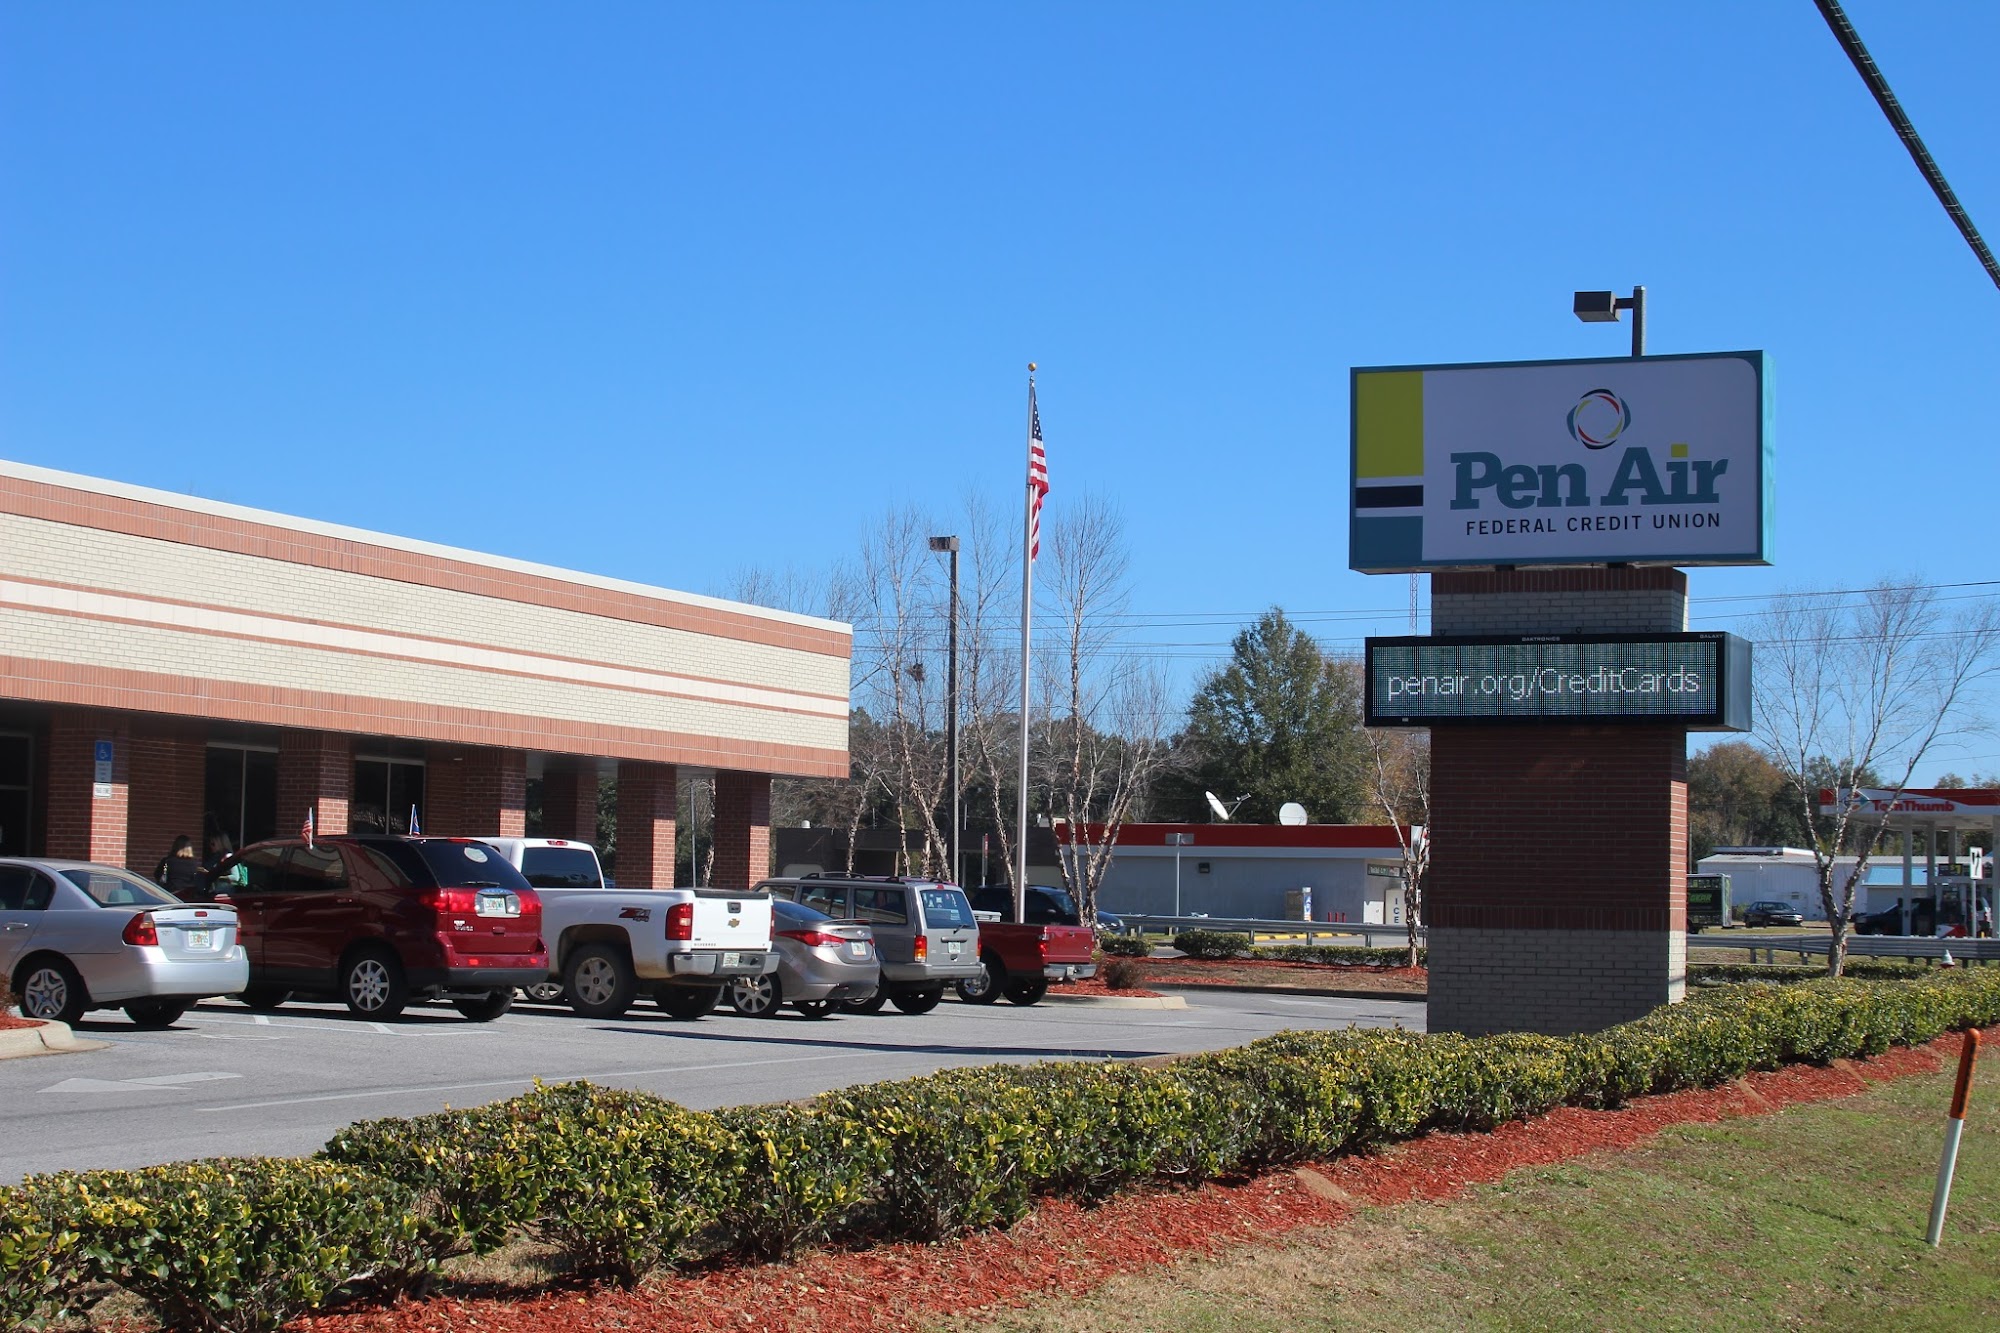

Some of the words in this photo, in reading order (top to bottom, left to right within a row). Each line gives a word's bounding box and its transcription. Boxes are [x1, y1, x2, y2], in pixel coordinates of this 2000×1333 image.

[1450, 452, 1591, 510] Pen
[1600, 444, 1729, 506] Air
[1466, 518, 1557, 536] FEDERAL
[1567, 515, 1642, 532] CREDIT
[1653, 513, 1720, 529] UNION
[1388, 664, 1700, 701] penair.org/CreditCards
